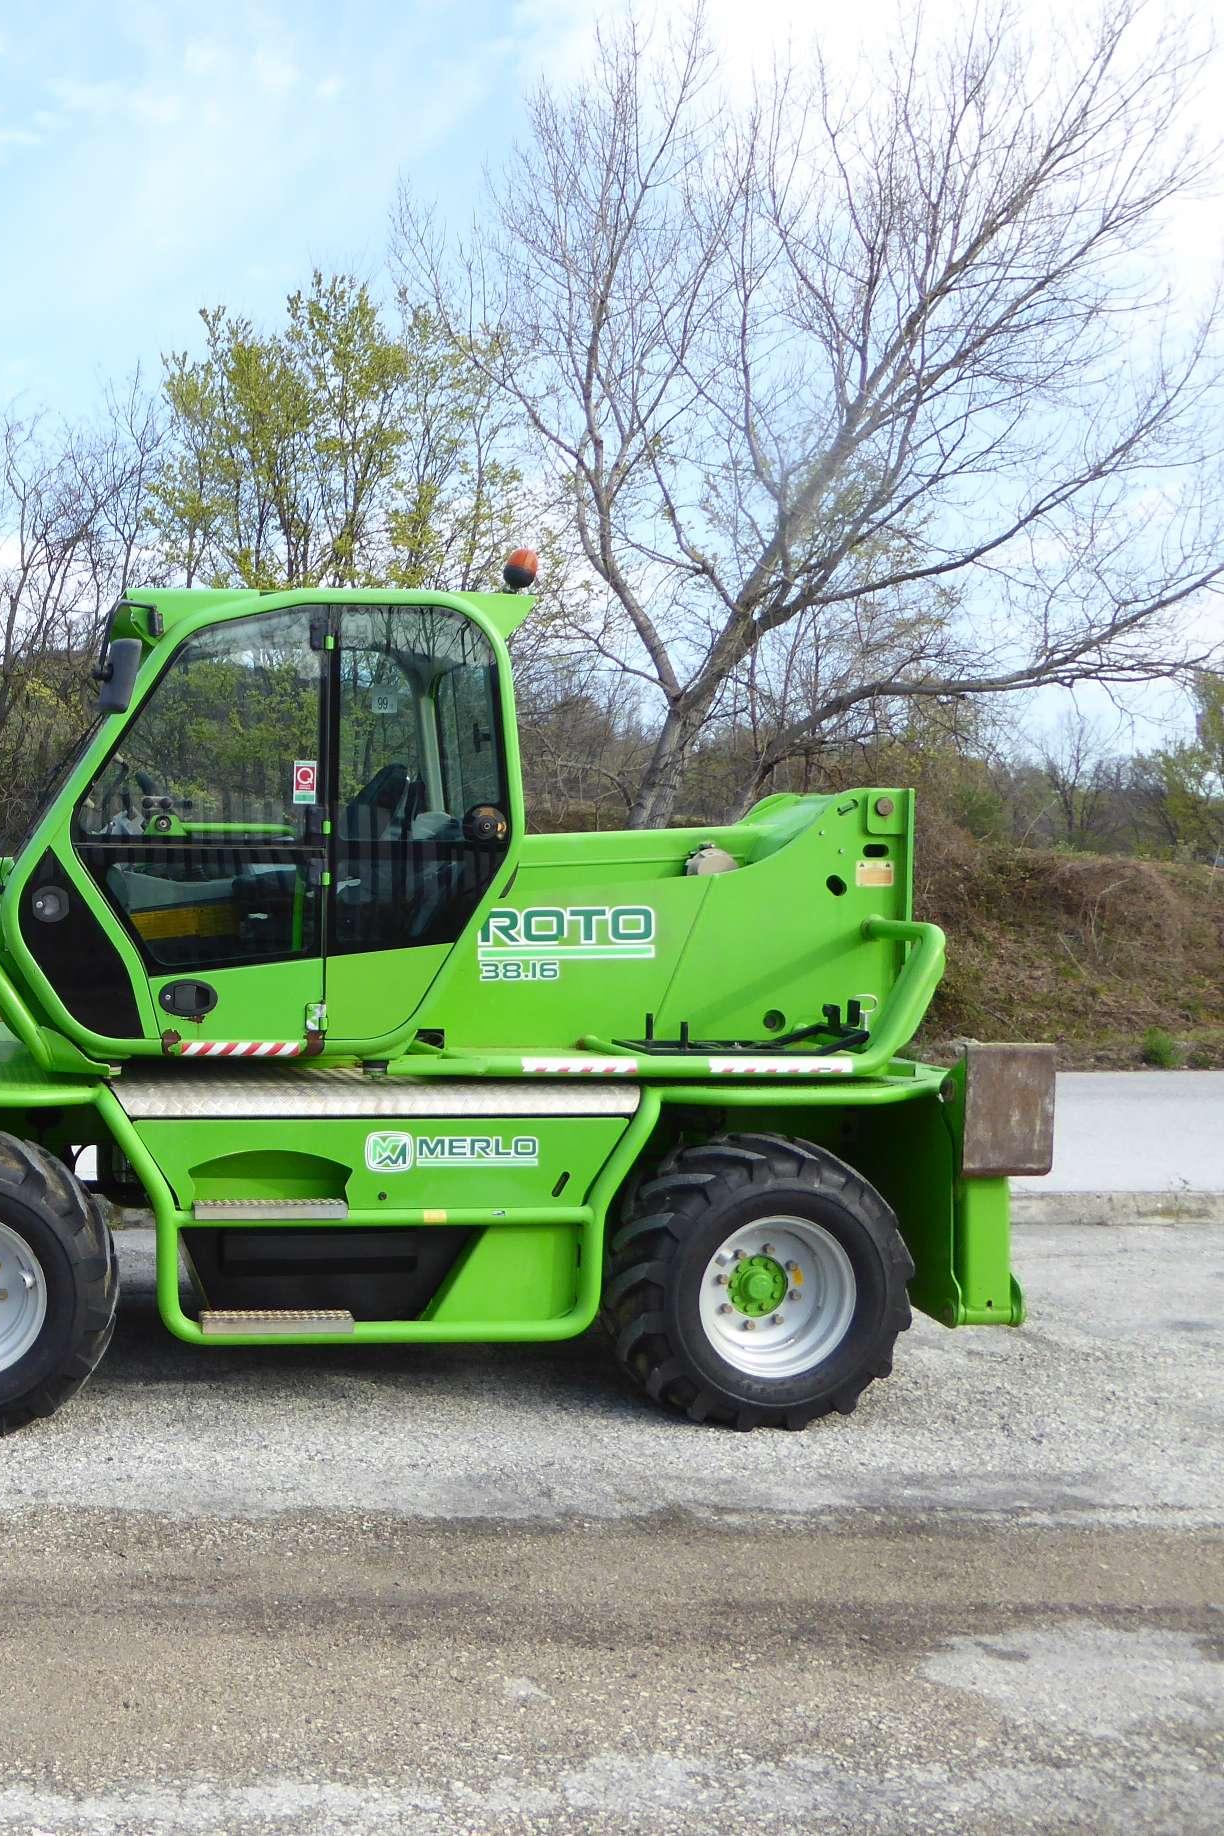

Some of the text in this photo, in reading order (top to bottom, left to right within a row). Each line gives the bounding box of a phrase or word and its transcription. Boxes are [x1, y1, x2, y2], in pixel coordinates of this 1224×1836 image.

[377, 697, 388, 709] 99
[297, 767, 314, 784] Q
[478, 905, 655, 945] ROTO
[480, 960, 559, 982] 38.16
[417, 1136, 538, 1158] MERLO
